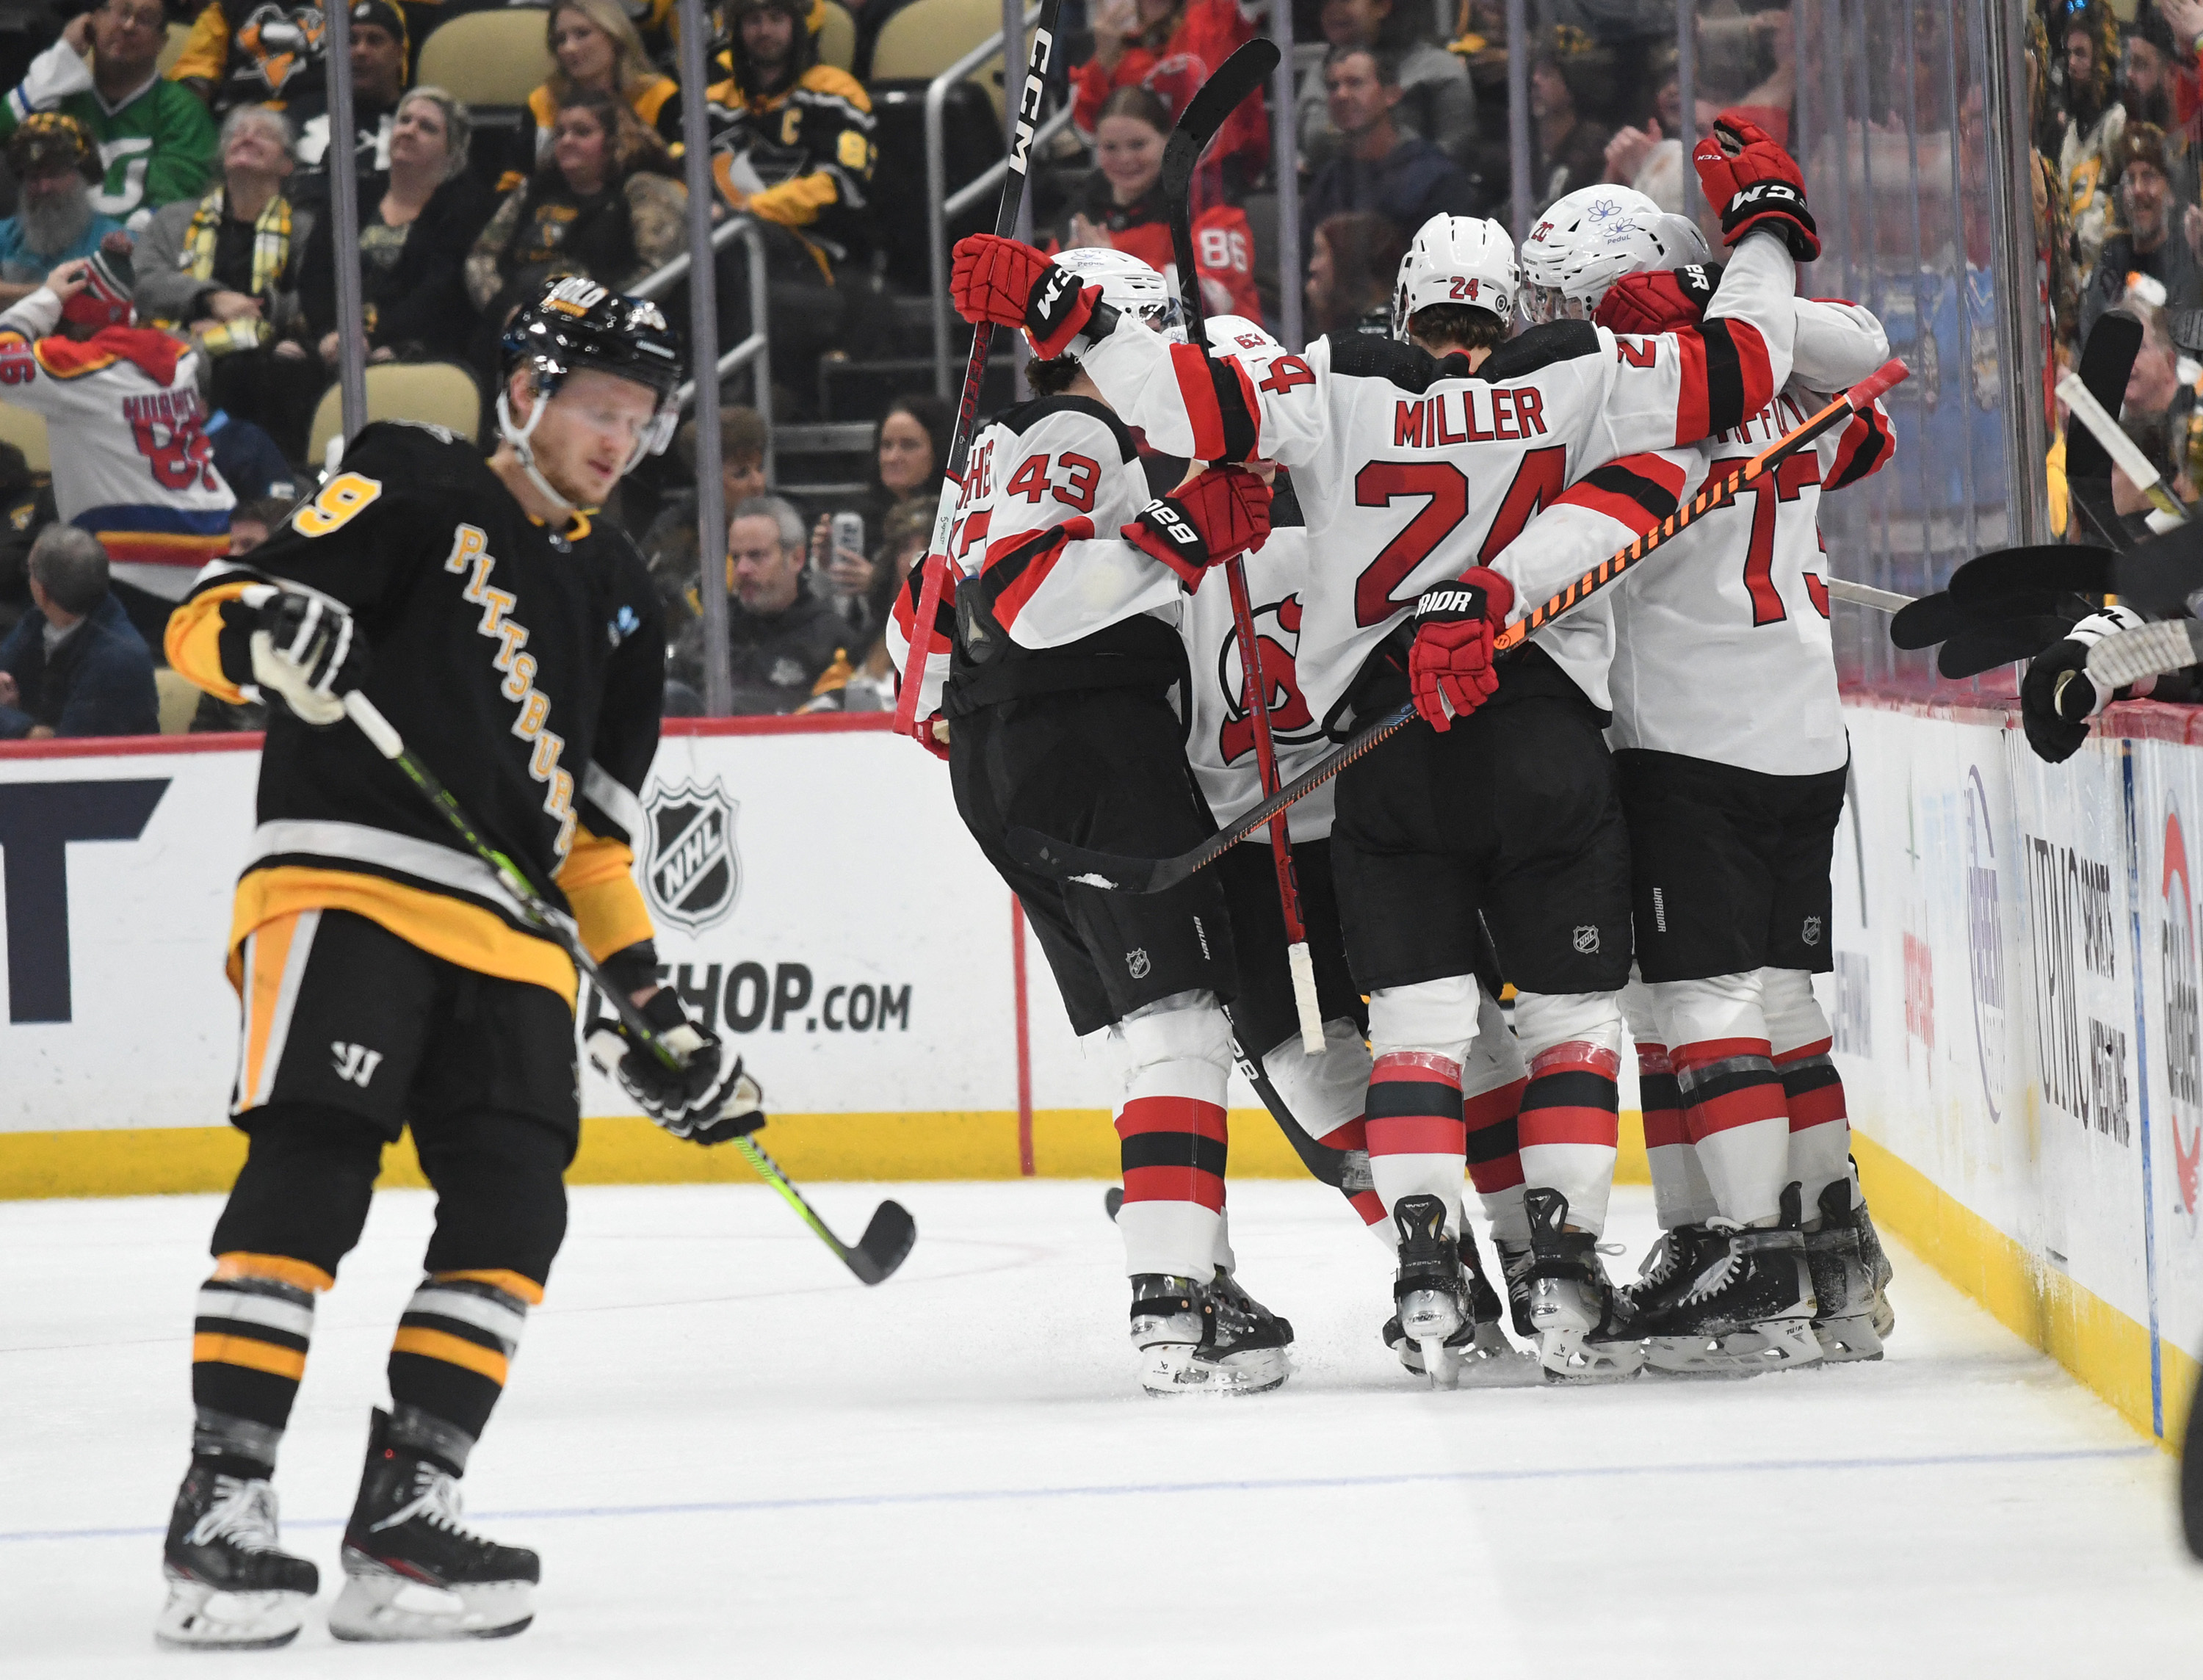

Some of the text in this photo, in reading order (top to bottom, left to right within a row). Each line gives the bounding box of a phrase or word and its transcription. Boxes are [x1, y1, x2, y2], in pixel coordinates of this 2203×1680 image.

[781, 106, 803, 145] C
[1008, 27, 1053, 175] CCM
[1200, 228, 1248, 273] 86
[1037, 267, 1075, 321] CM
[1449, 275, 1479, 302] 24
[1234, 333, 1267, 350] 63
[1394, 386, 1548, 449] MILLER
[292, 471, 383, 538] 9
[1006, 450, 1102, 514] 43
[1414, 590, 1472, 620] RIOR
[444, 522, 578, 880] PITTSBUR
[664, 817, 720, 900] NHL
[1193, 916, 1211, 960] BAUER
[1579, 928, 1596, 947] NHL
[1653, 887, 1666, 933] WARRIOR
[2081, 855, 2115, 980] SPORTS
[658, 960, 911, 1033] HOP.COM
[2025, 833, 2089, 1130] UPMC
